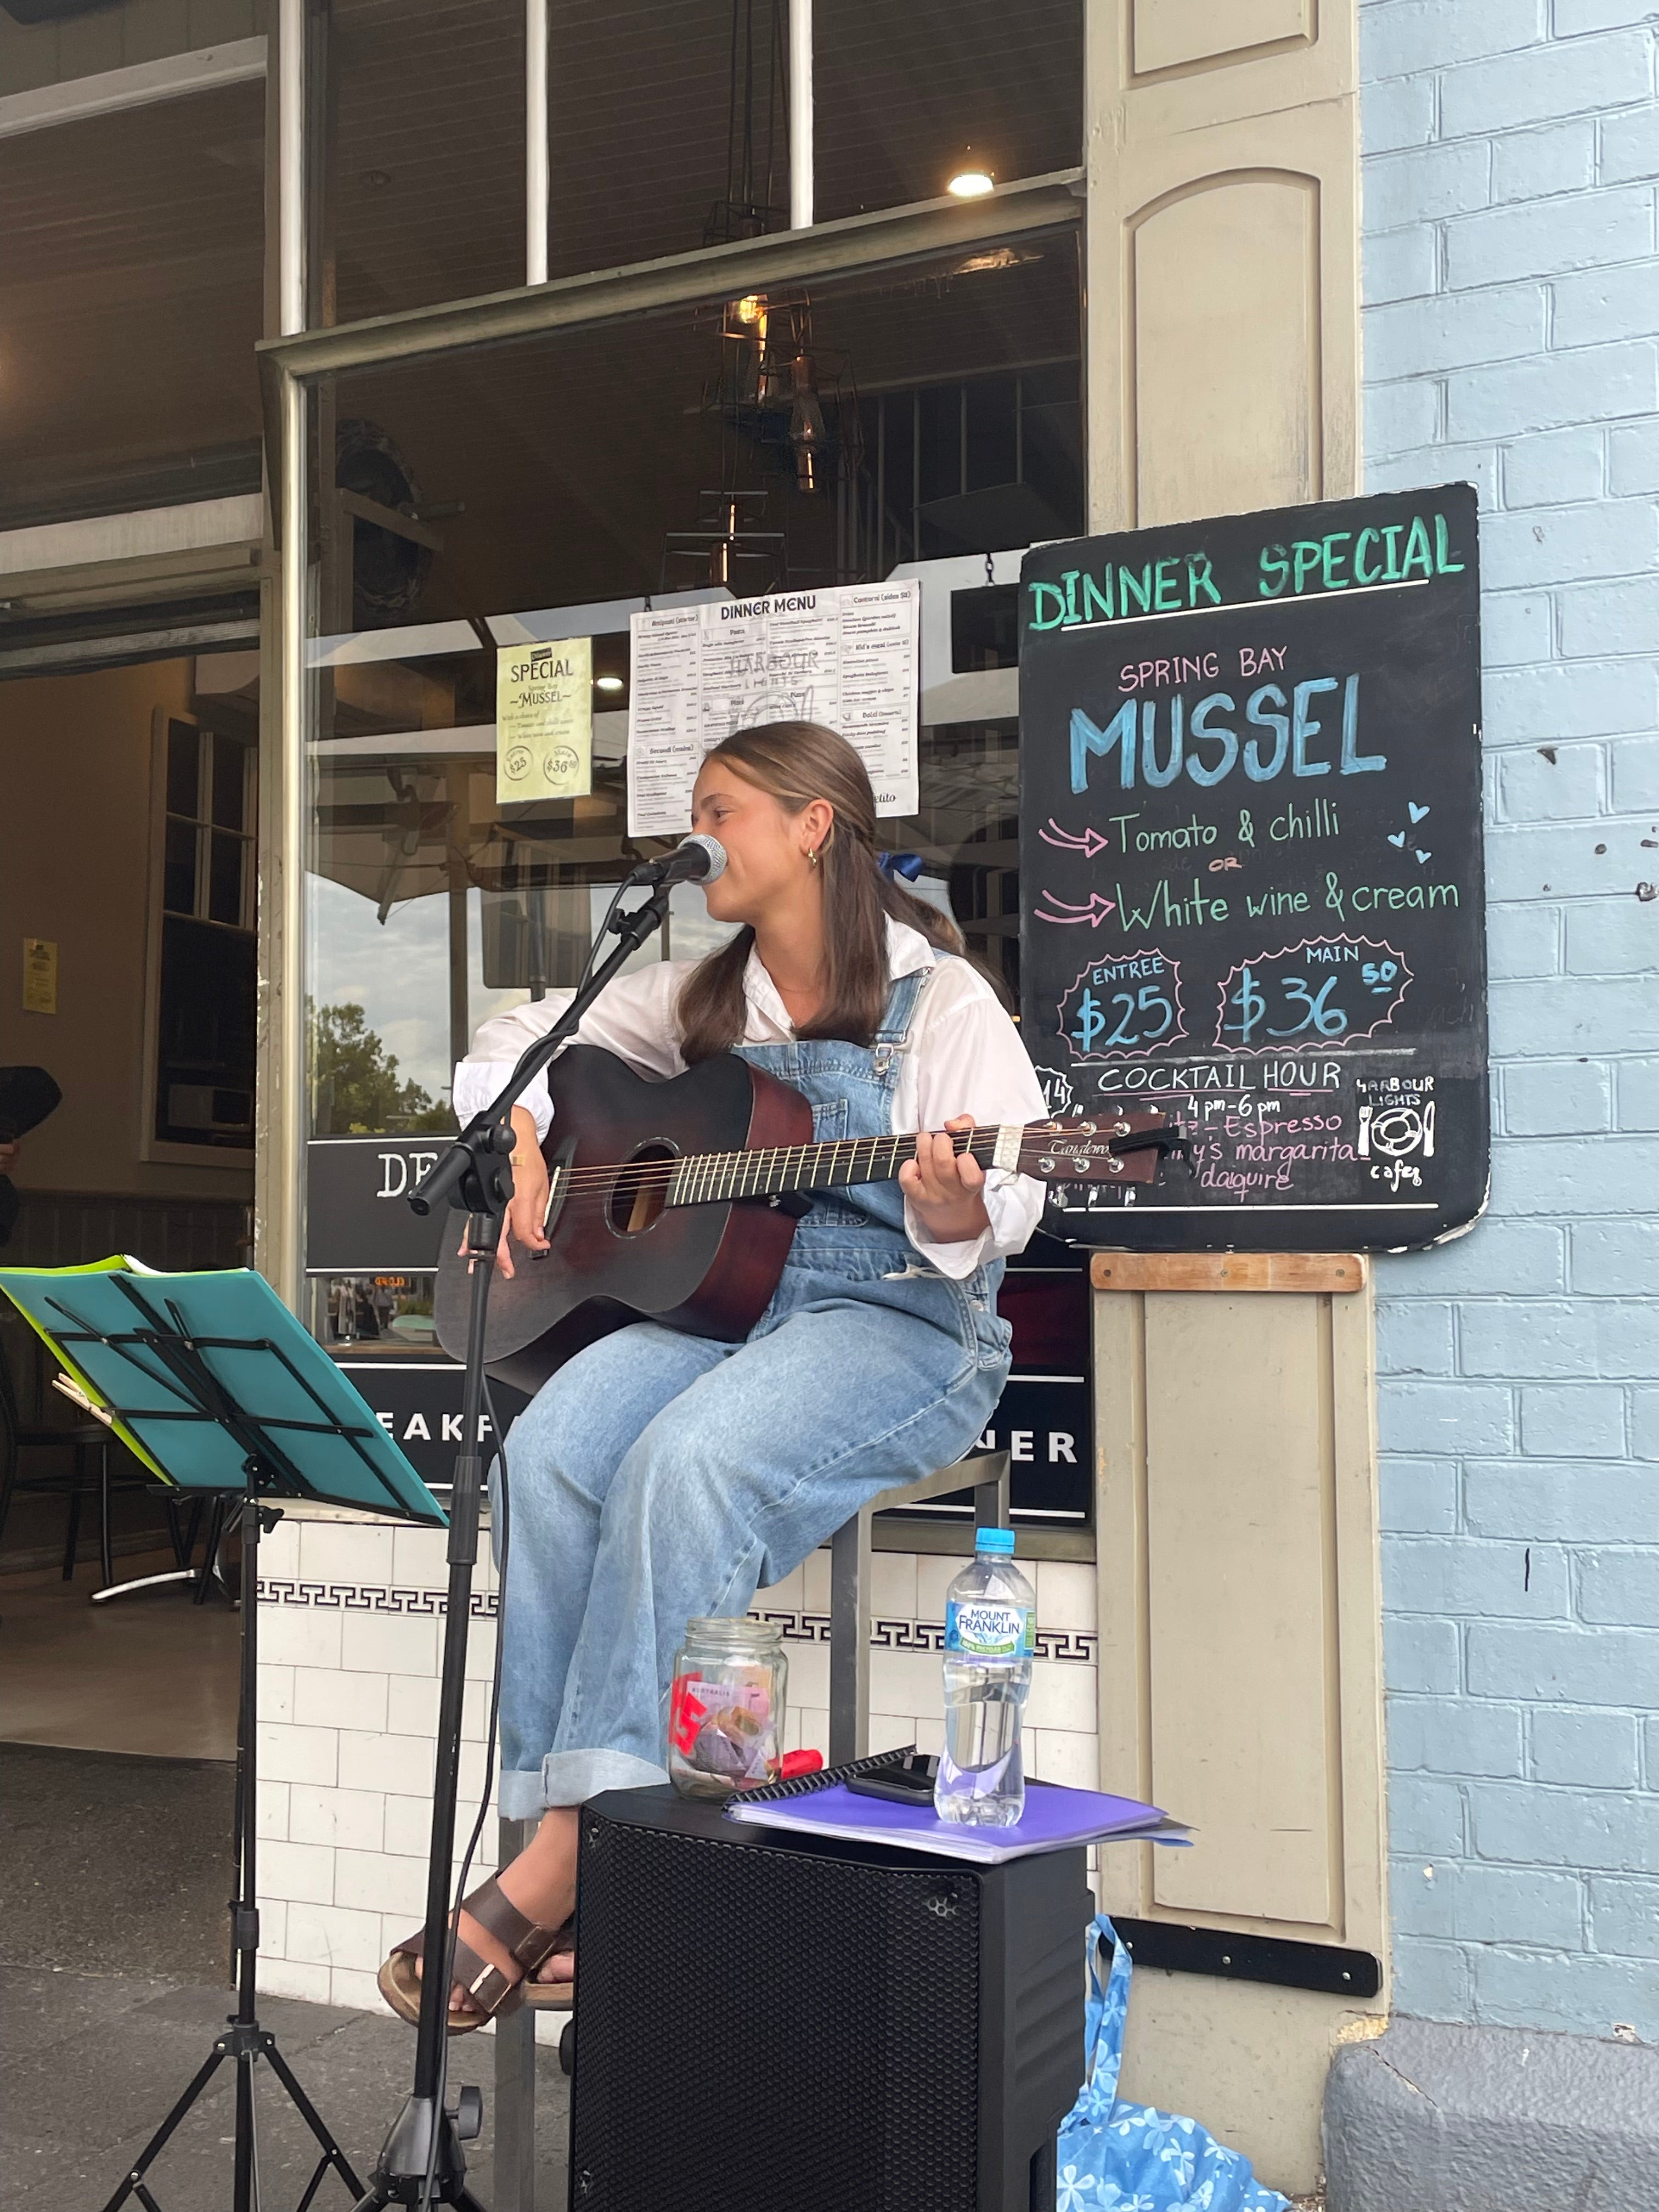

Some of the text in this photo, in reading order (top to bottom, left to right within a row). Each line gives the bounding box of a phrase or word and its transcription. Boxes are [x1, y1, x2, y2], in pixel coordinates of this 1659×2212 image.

[1028, 514, 1465, 631] DINNER SPECIAL
[721, 595, 816, 620] DINNER MENU
[511, 659, 573, 683] SPECIAL
[1118, 646, 1287, 692] SPRING BAY
[1069, 673, 1387, 794] MUSSEL
[510, 757, 527, 775] $25
[1109, 798, 1340, 855] Tomato & chilli
[1115, 872, 1460, 932] White wine & cream
[1306, 946, 1359, 964] MAIN
[1092, 956, 1165, 986] ENTREE
[1071, 985, 1172, 1052] $25
[1097, 1063, 1341, 1091] COCKTAIL HOUR
[1368, 1094, 1421, 1106] LIGHTS
[1236, 1137, 1358, 1176] margarita
[959, 1615, 1020, 1634] FRANKLIN
[970, 1609, 1011, 1622] MOUNT
